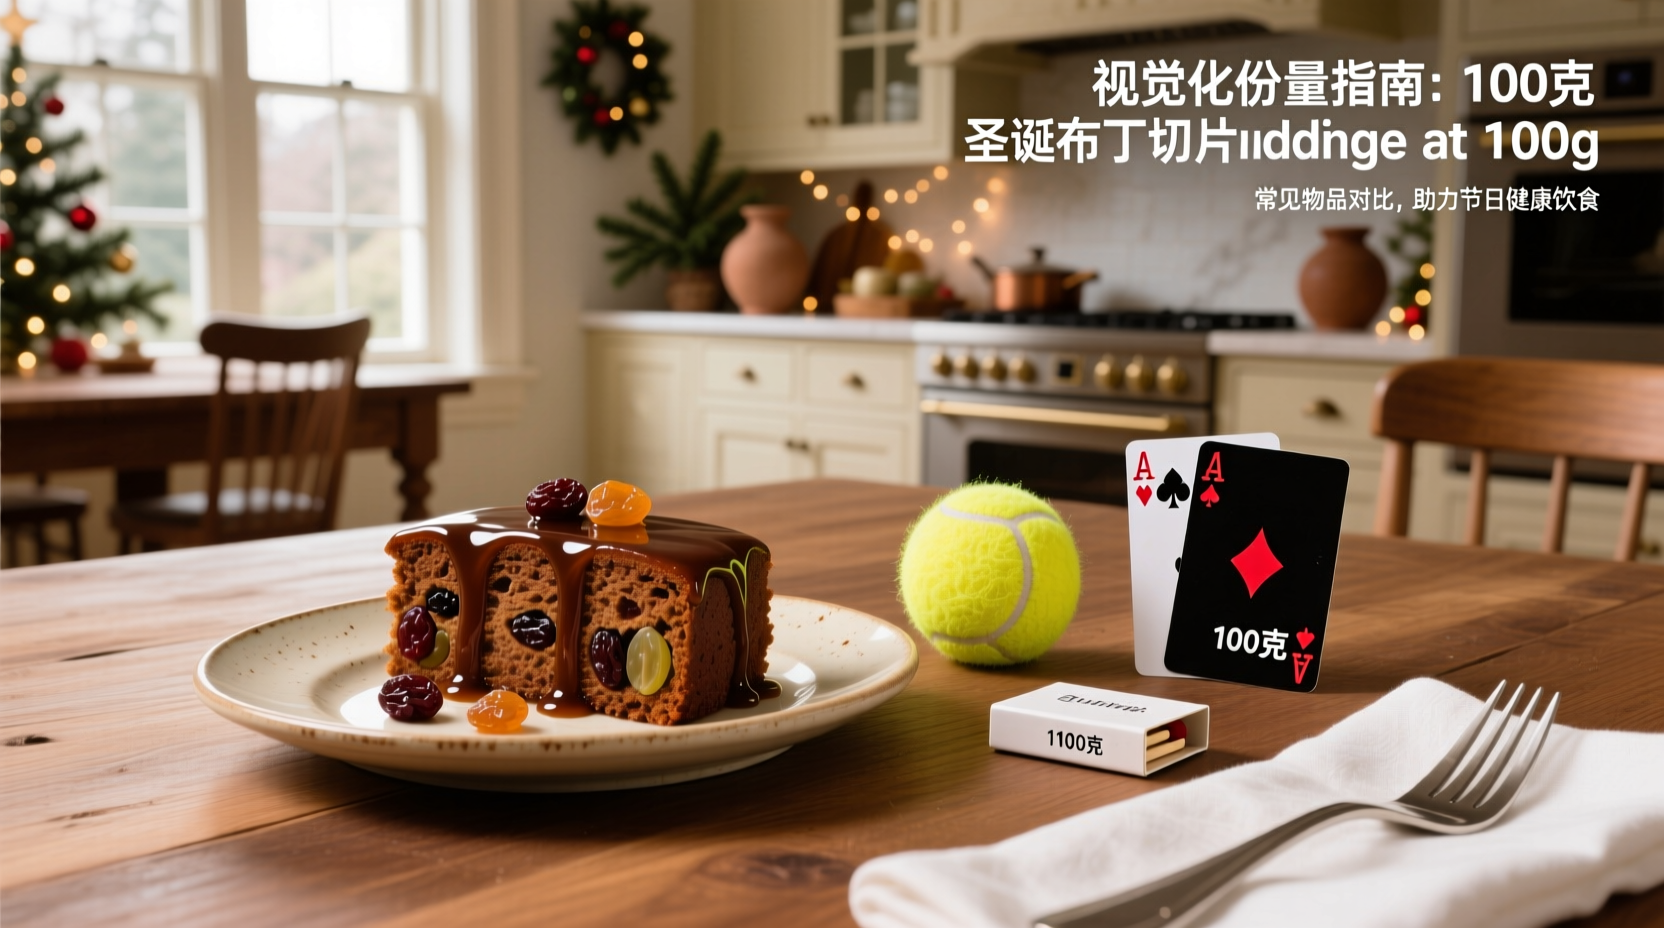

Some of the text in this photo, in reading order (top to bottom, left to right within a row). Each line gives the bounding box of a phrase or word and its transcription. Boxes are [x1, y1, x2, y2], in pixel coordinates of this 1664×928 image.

[1133, 451, 1155, 481] A
[1201, 451, 1225, 482] A
[1214, 625, 1289, 661] 100克
[1292, 652, 1314, 685] A
[1047, 729, 1104, 756] 1100克
